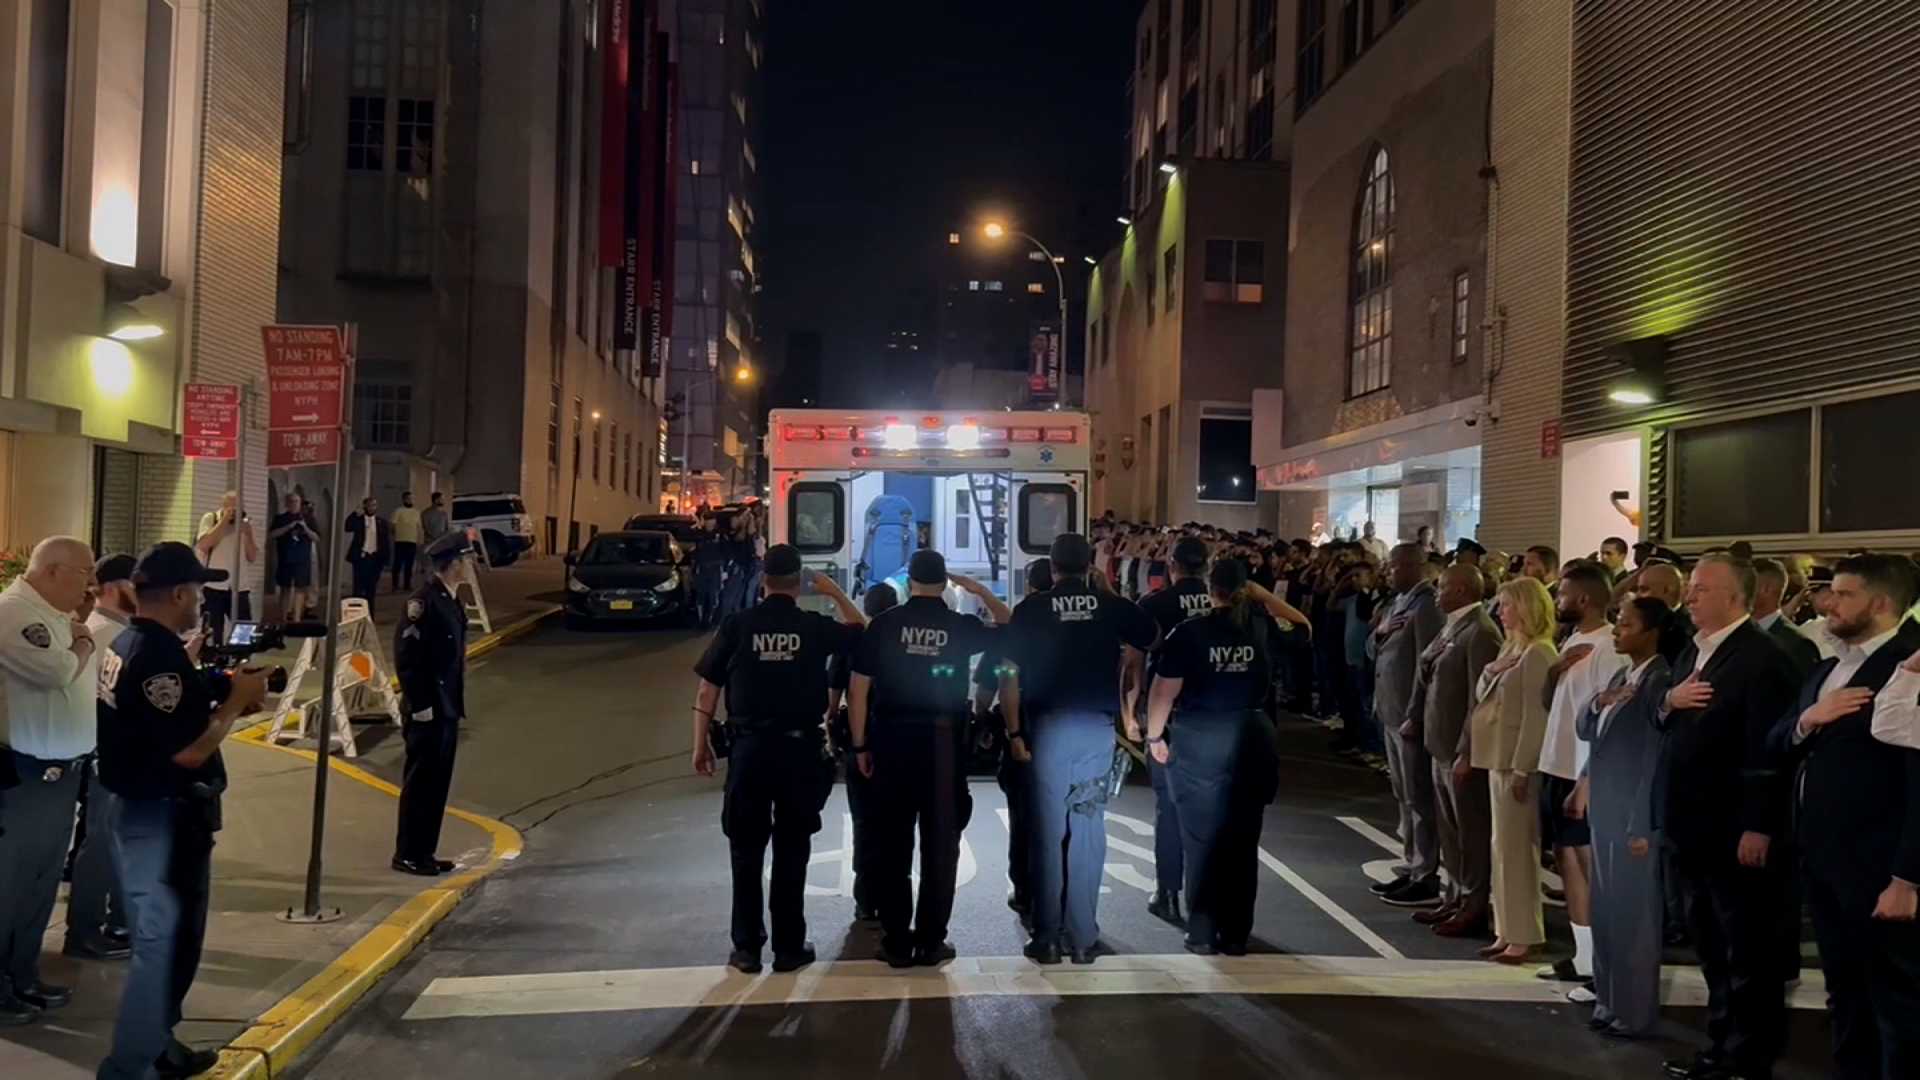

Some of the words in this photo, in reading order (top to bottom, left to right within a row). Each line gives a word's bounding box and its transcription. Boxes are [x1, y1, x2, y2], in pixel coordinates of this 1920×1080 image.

[623, 275, 636, 336] ENTRANCE
[268, 330, 283, 343] NO
[286, 330, 333, 344] STANDING
[649, 312, 661, 365] ENTRANCE
[292, 446, 318, 462] ZONE
[1051, 594, 1098, 612] NYPD
[1178, 593, 1212, 609] NYP
[752, 633, 801, 652] NYPD
[900, 626, 949, 647] NYPD
[1209, 645, 1255, 663] NYPD
